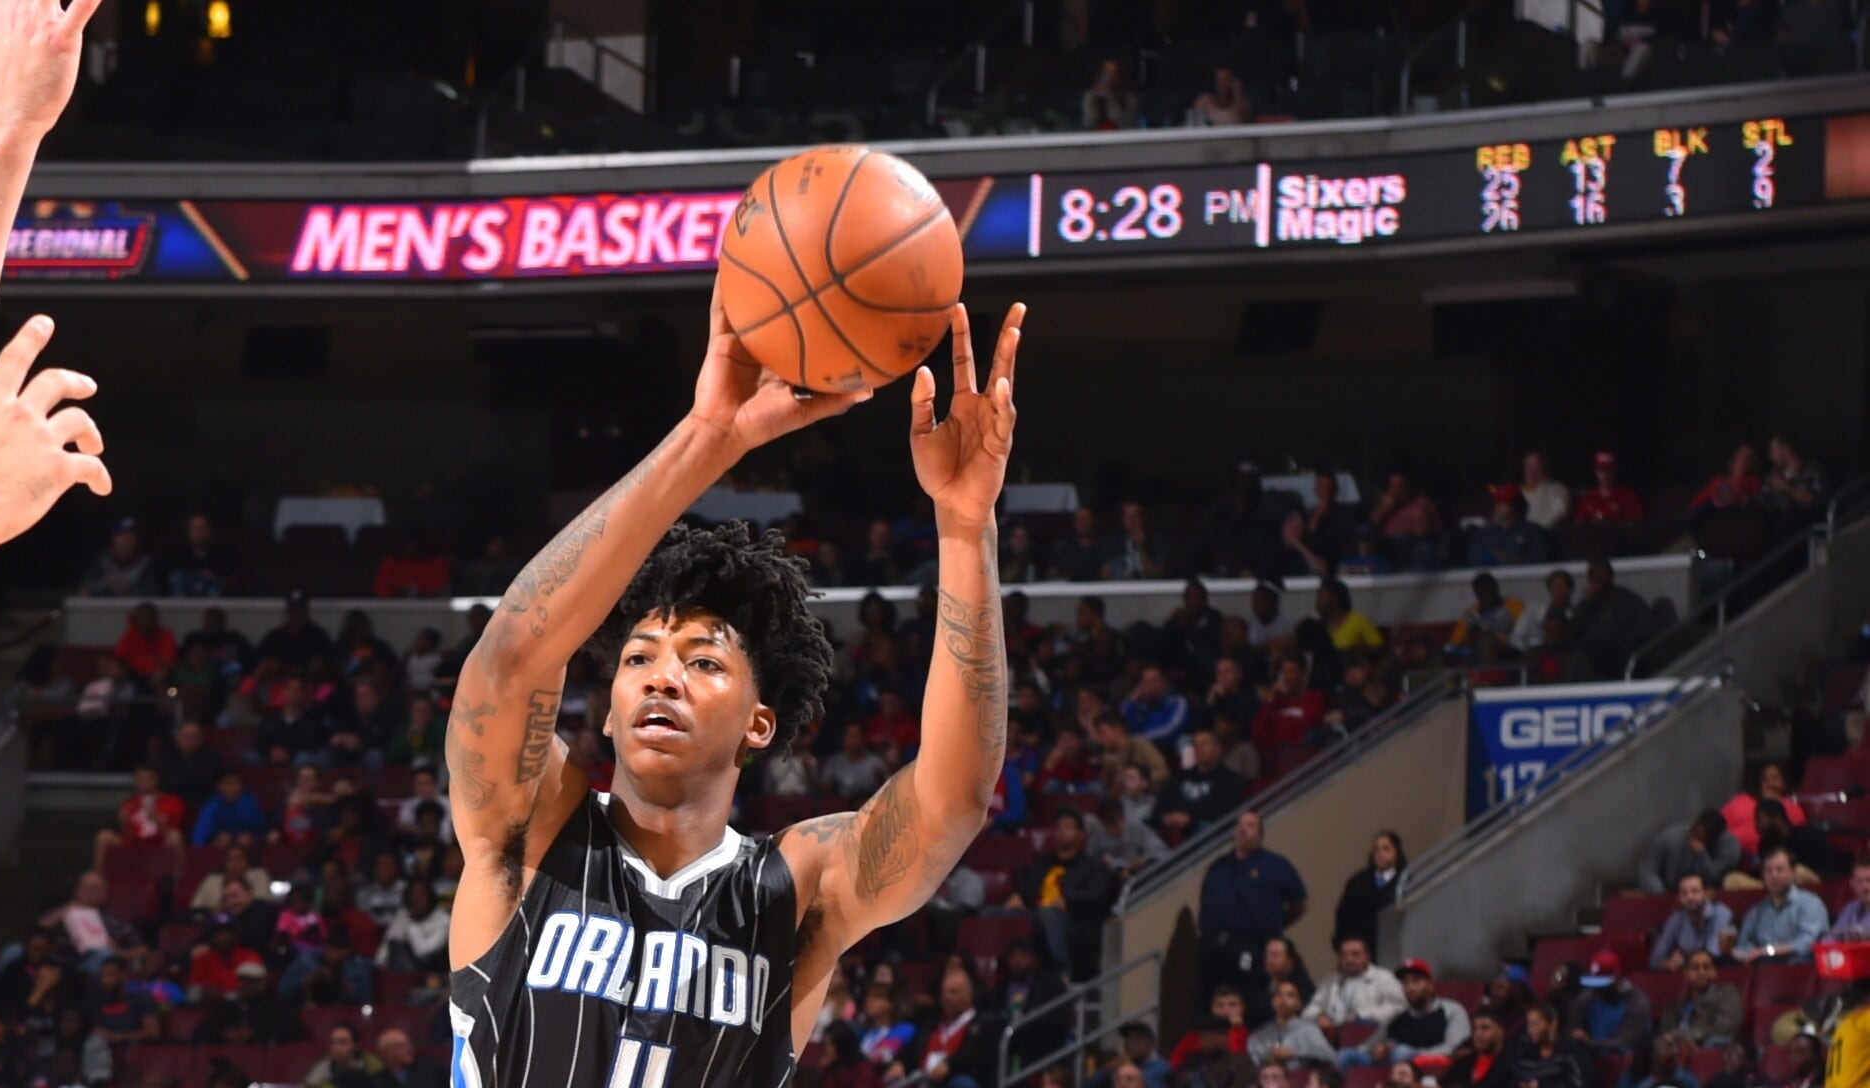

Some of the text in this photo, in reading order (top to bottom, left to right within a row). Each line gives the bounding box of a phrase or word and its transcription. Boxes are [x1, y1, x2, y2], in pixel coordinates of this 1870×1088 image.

[1560, 135, 1617, 166] AST
[1654, 127, 1709, 157] BLK
[1742, 118, 1793, 149] STL
[1569, 158, 1606, 193] 13
[1753, 141, 1774, 176] 2
[1058, 184, 1259, 242] 8:28 PM
[1277, 172, 1406, 208] Sixers
[292, 206, 506, 273] MEN'S
[1276, 205, 1400, 243] Magic
[526, 909, 770, 1035] ORLANDO
